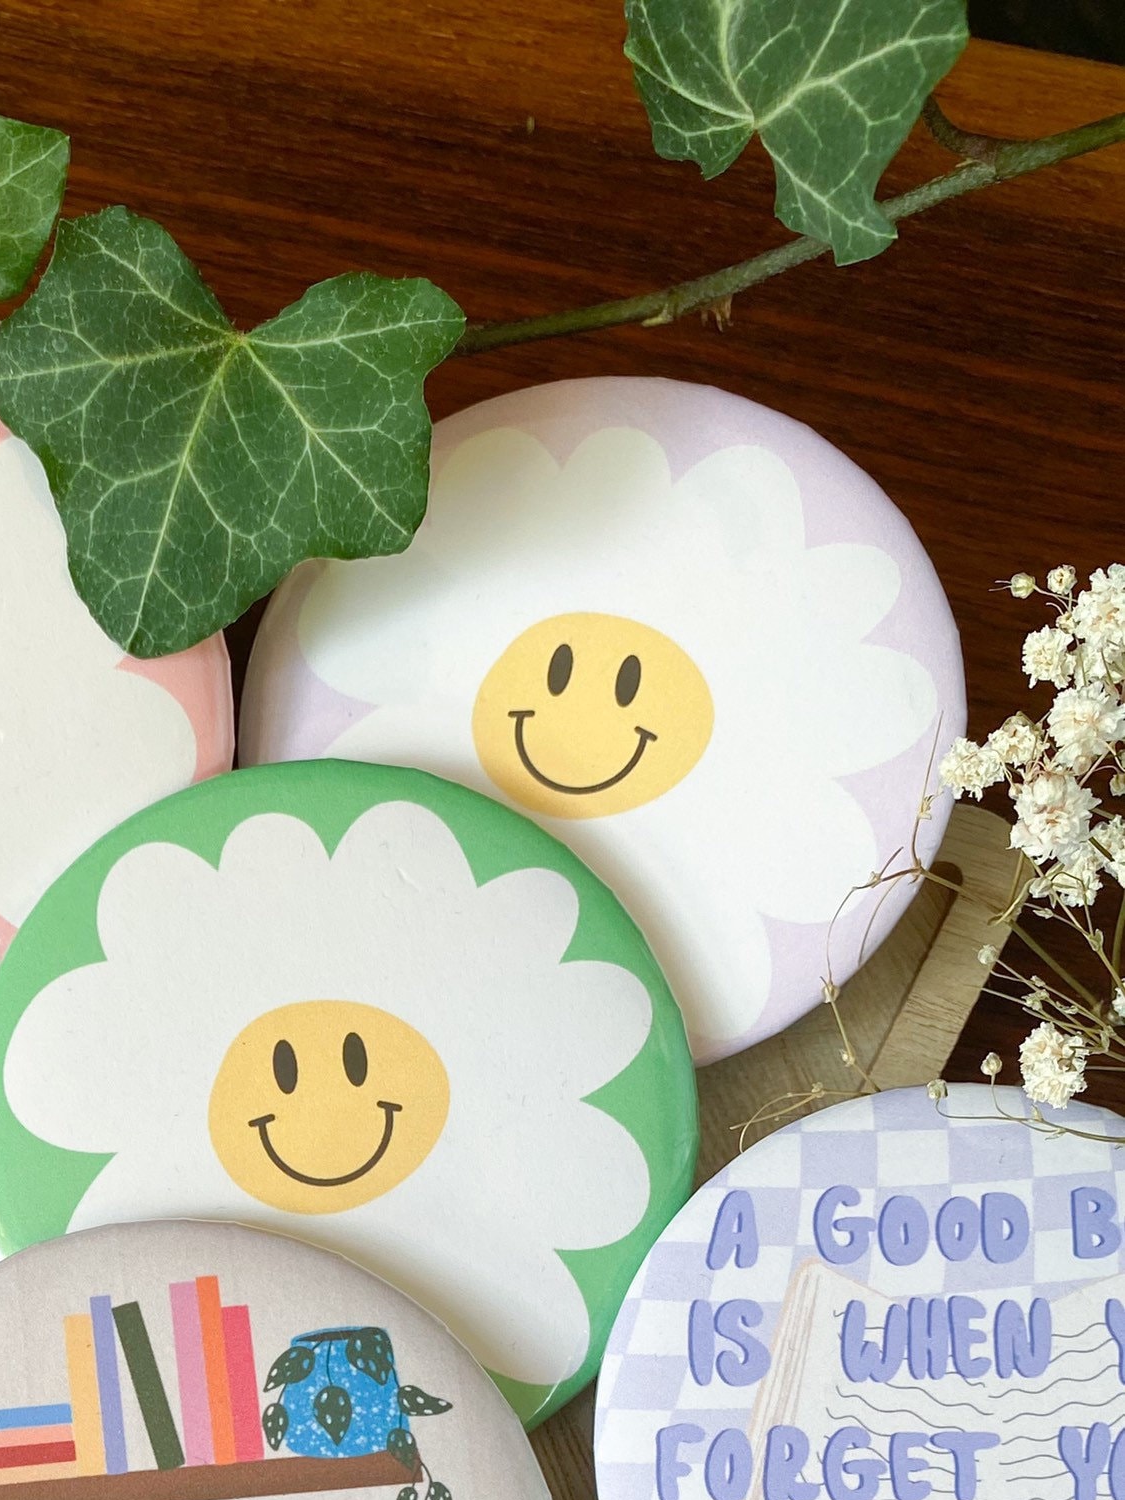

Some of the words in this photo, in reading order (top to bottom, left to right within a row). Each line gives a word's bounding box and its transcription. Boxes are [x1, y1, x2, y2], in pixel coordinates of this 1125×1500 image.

[707, 1190, 760, 1270] A
[813, 1185, 1030, 1265] GOOD
[688, 1298, 771, 1386] IS
[840, 1296, 1052, 1383] WHEN
